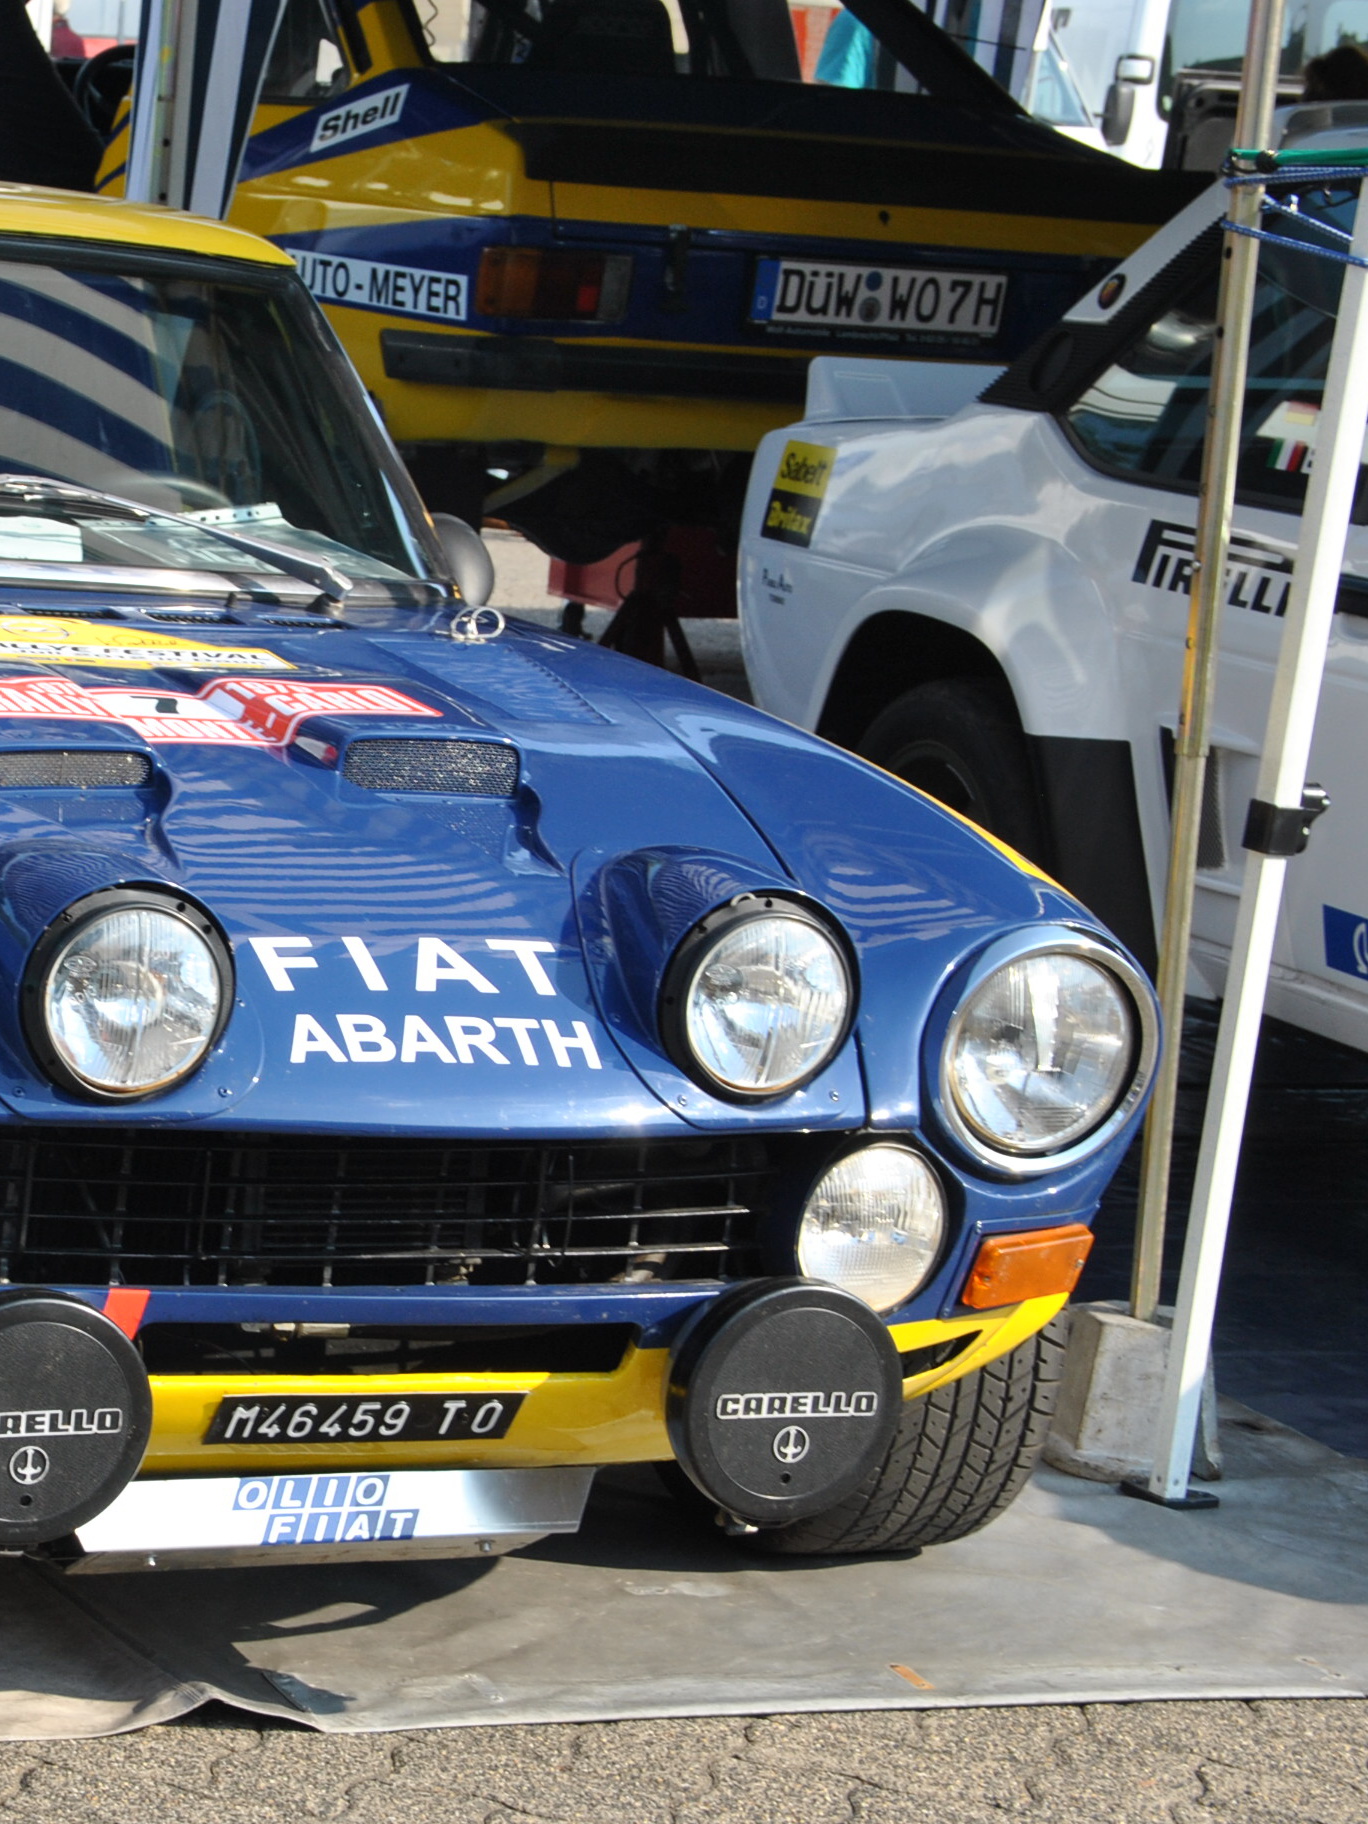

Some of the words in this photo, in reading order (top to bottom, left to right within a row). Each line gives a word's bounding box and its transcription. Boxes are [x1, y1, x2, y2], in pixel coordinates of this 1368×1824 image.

[319, 92, 401, 142] Shell
[295, 254, 462, 317] UTO-MEYER
[1132, 518, 1294, 617] PIRLLI
[102, 647, 269, 661] FESTIVAL
[264, 689, 414, 717] CARLO
[248, 936, 557, 996] FIAT
[290, 1013, 603, 1069] ABARTH
[224, 1401, 411, 1438] M46459
[716, 1391, 878, 1420] CARELLO
[237, 1477, 386, 1510] OLIO
[267, 1511, 414, 1545] FIAT
